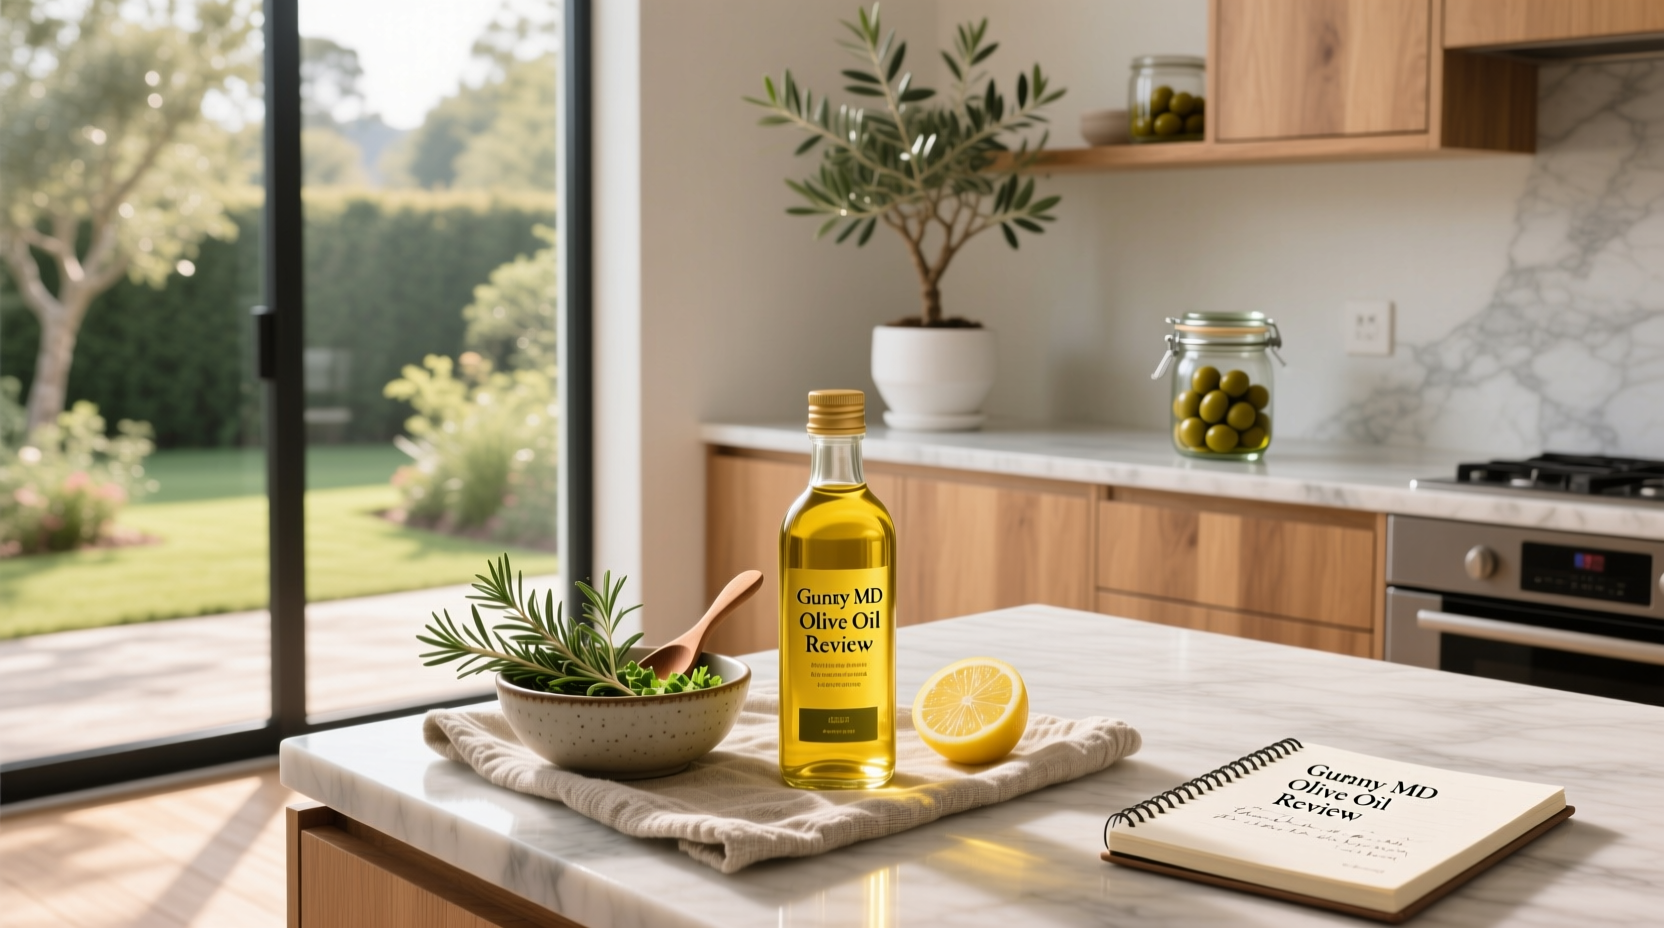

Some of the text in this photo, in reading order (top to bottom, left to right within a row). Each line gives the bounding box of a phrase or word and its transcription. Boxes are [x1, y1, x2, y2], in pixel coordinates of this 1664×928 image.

[854, 587, 883, 605] MD
[799, 610, 880, 630] Olive Oil
[805, 635, 873, 653] Review
[1288, 779, 1392, 811] Olive Oil
[1390, 780, 1439, 800] MD
[1272, 792, 1363, 822] Review
